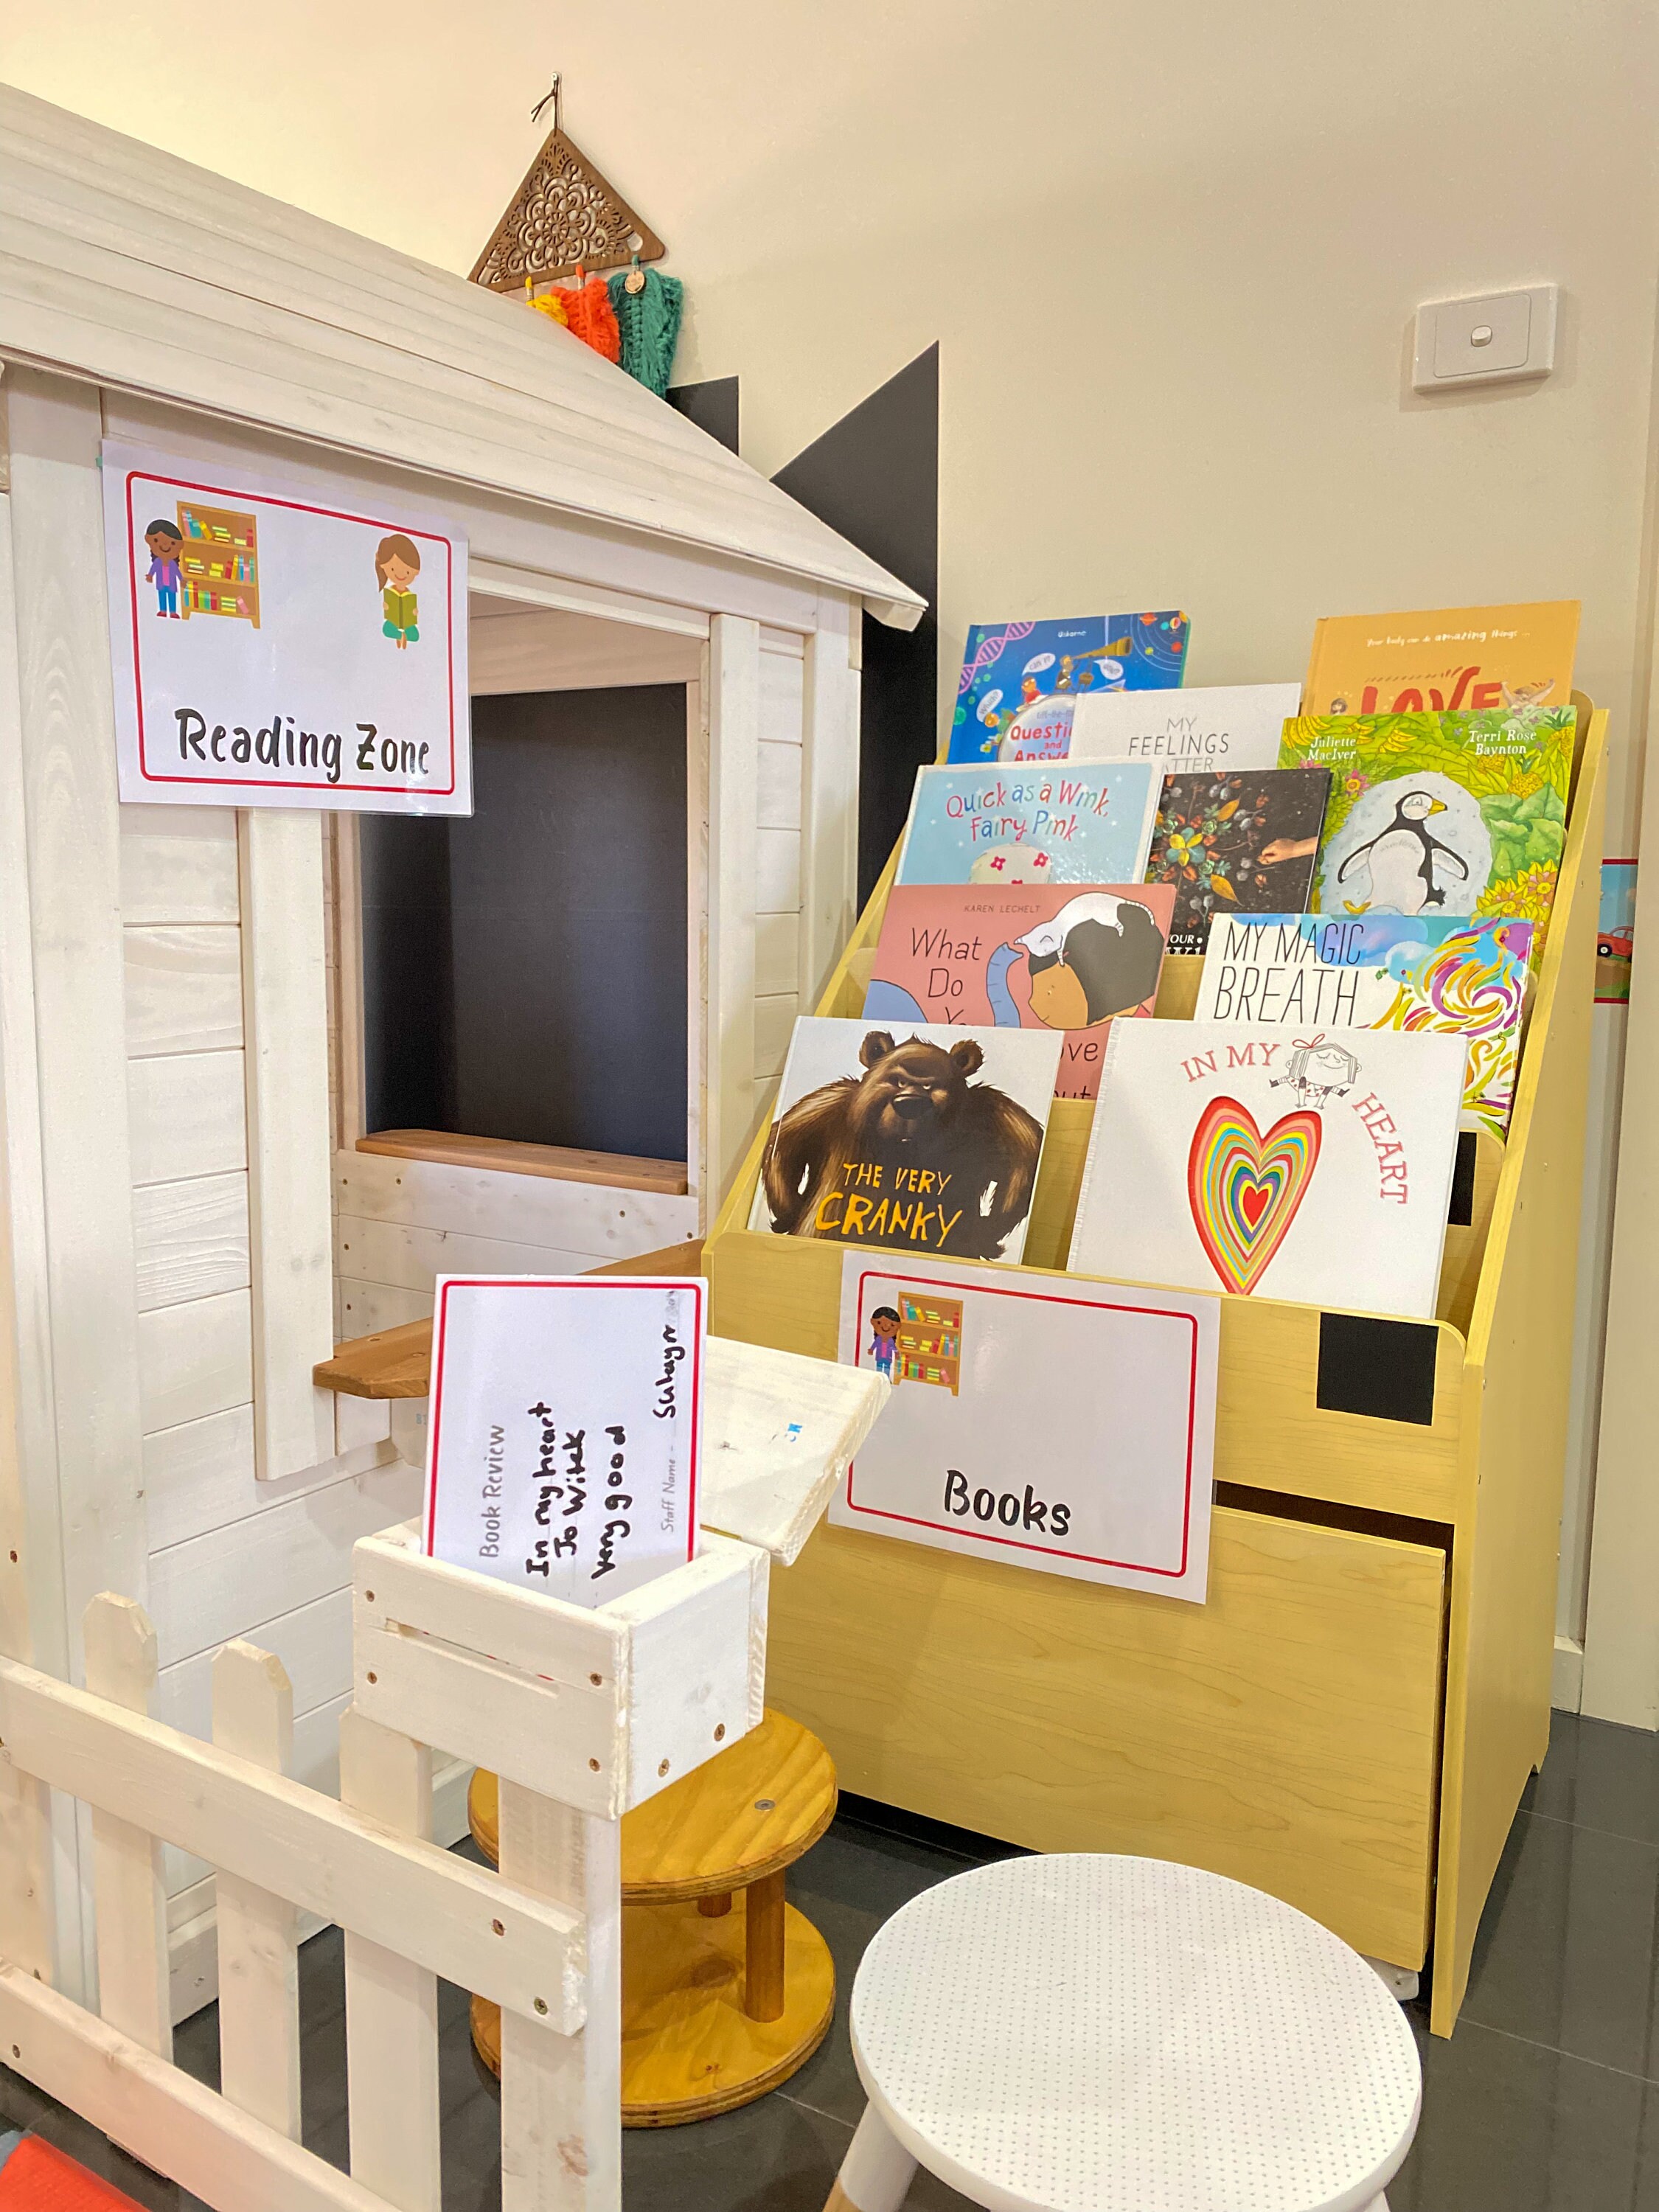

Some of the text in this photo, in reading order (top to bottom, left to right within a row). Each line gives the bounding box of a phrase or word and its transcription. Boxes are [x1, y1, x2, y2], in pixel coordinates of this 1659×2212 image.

[1434, 630, 1487, 643] amazing
[1010, 721, 1073, 741] Questi
[1166, 717, 1197, 733] MY
[1469, 728, 1537, 744] Terri Rose
[174, 708, 430, 784] Reading Zone
[1015, 749, 1069, 762] Answe
[1044, 740, 1062, 749] and
[1128, 733, 1230, 757] FEELINGS
[1307, 747, 1356, 761] MacIver
[1310, 735, 1356, 749] Juliette
[1475, 743, 1528, 757] Baynton
[1165, 757, 1214, 773] TTER
[946, 779, 1110, 818] Quick as a Wink,
[970, 810, 1079, 842] Fairy Pink
[964, 904, 1042, 914] KAREN LECHELT
[911, 926, 983, 961] What
[1169, 933, 1195, 945] OUR
[1222, 921, 1365, 966] MY MAGIC
[927, 967, 964, 999] Do
[1213, 965, 1360, 1026] BREATH
[1180, 1042, 1409, 1206] IN MY HEART
[842, 1161, 953, 1196] THE VERY
[814, 1191, 964, 1248] CRANKY
[604, 1425, 633, 1512] good
[479, 1424, 505, 1559] Book Review
[526, 1402, 565, 1578] In my heart
[660, 1457, 677, 1533] Staff Name
[943, 1468, 1072, 1537] Books
[553, 1525, 579, 1559] Jo
